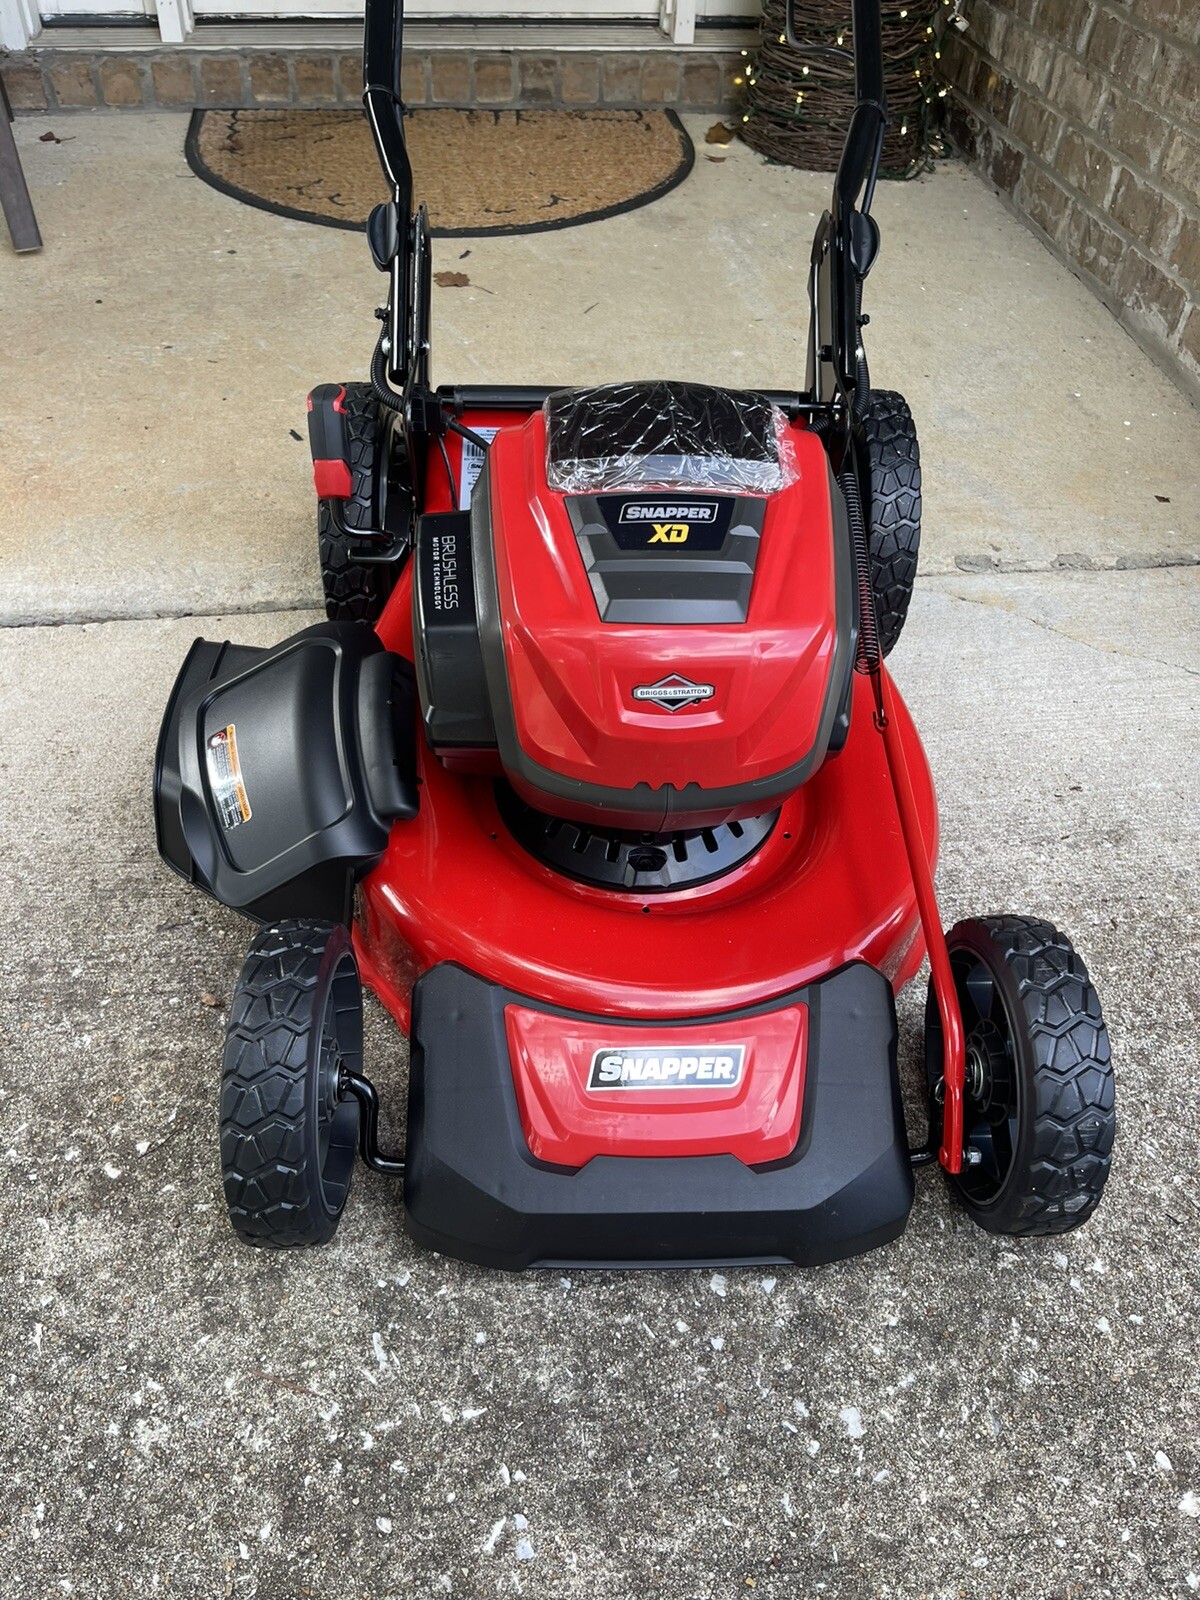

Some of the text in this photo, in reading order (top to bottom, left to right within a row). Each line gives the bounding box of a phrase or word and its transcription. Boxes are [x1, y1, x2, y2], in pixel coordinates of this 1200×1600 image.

[626, 506, 711, 519] SNAPPER
[647, 524, 690, 543] XD
[432, 537, 442, 610] MOTOR TECHNOLOGY
[441, 535, 459, 610] BRUSHLESS
[599, 1056, 735, 1081] SNAPPER
